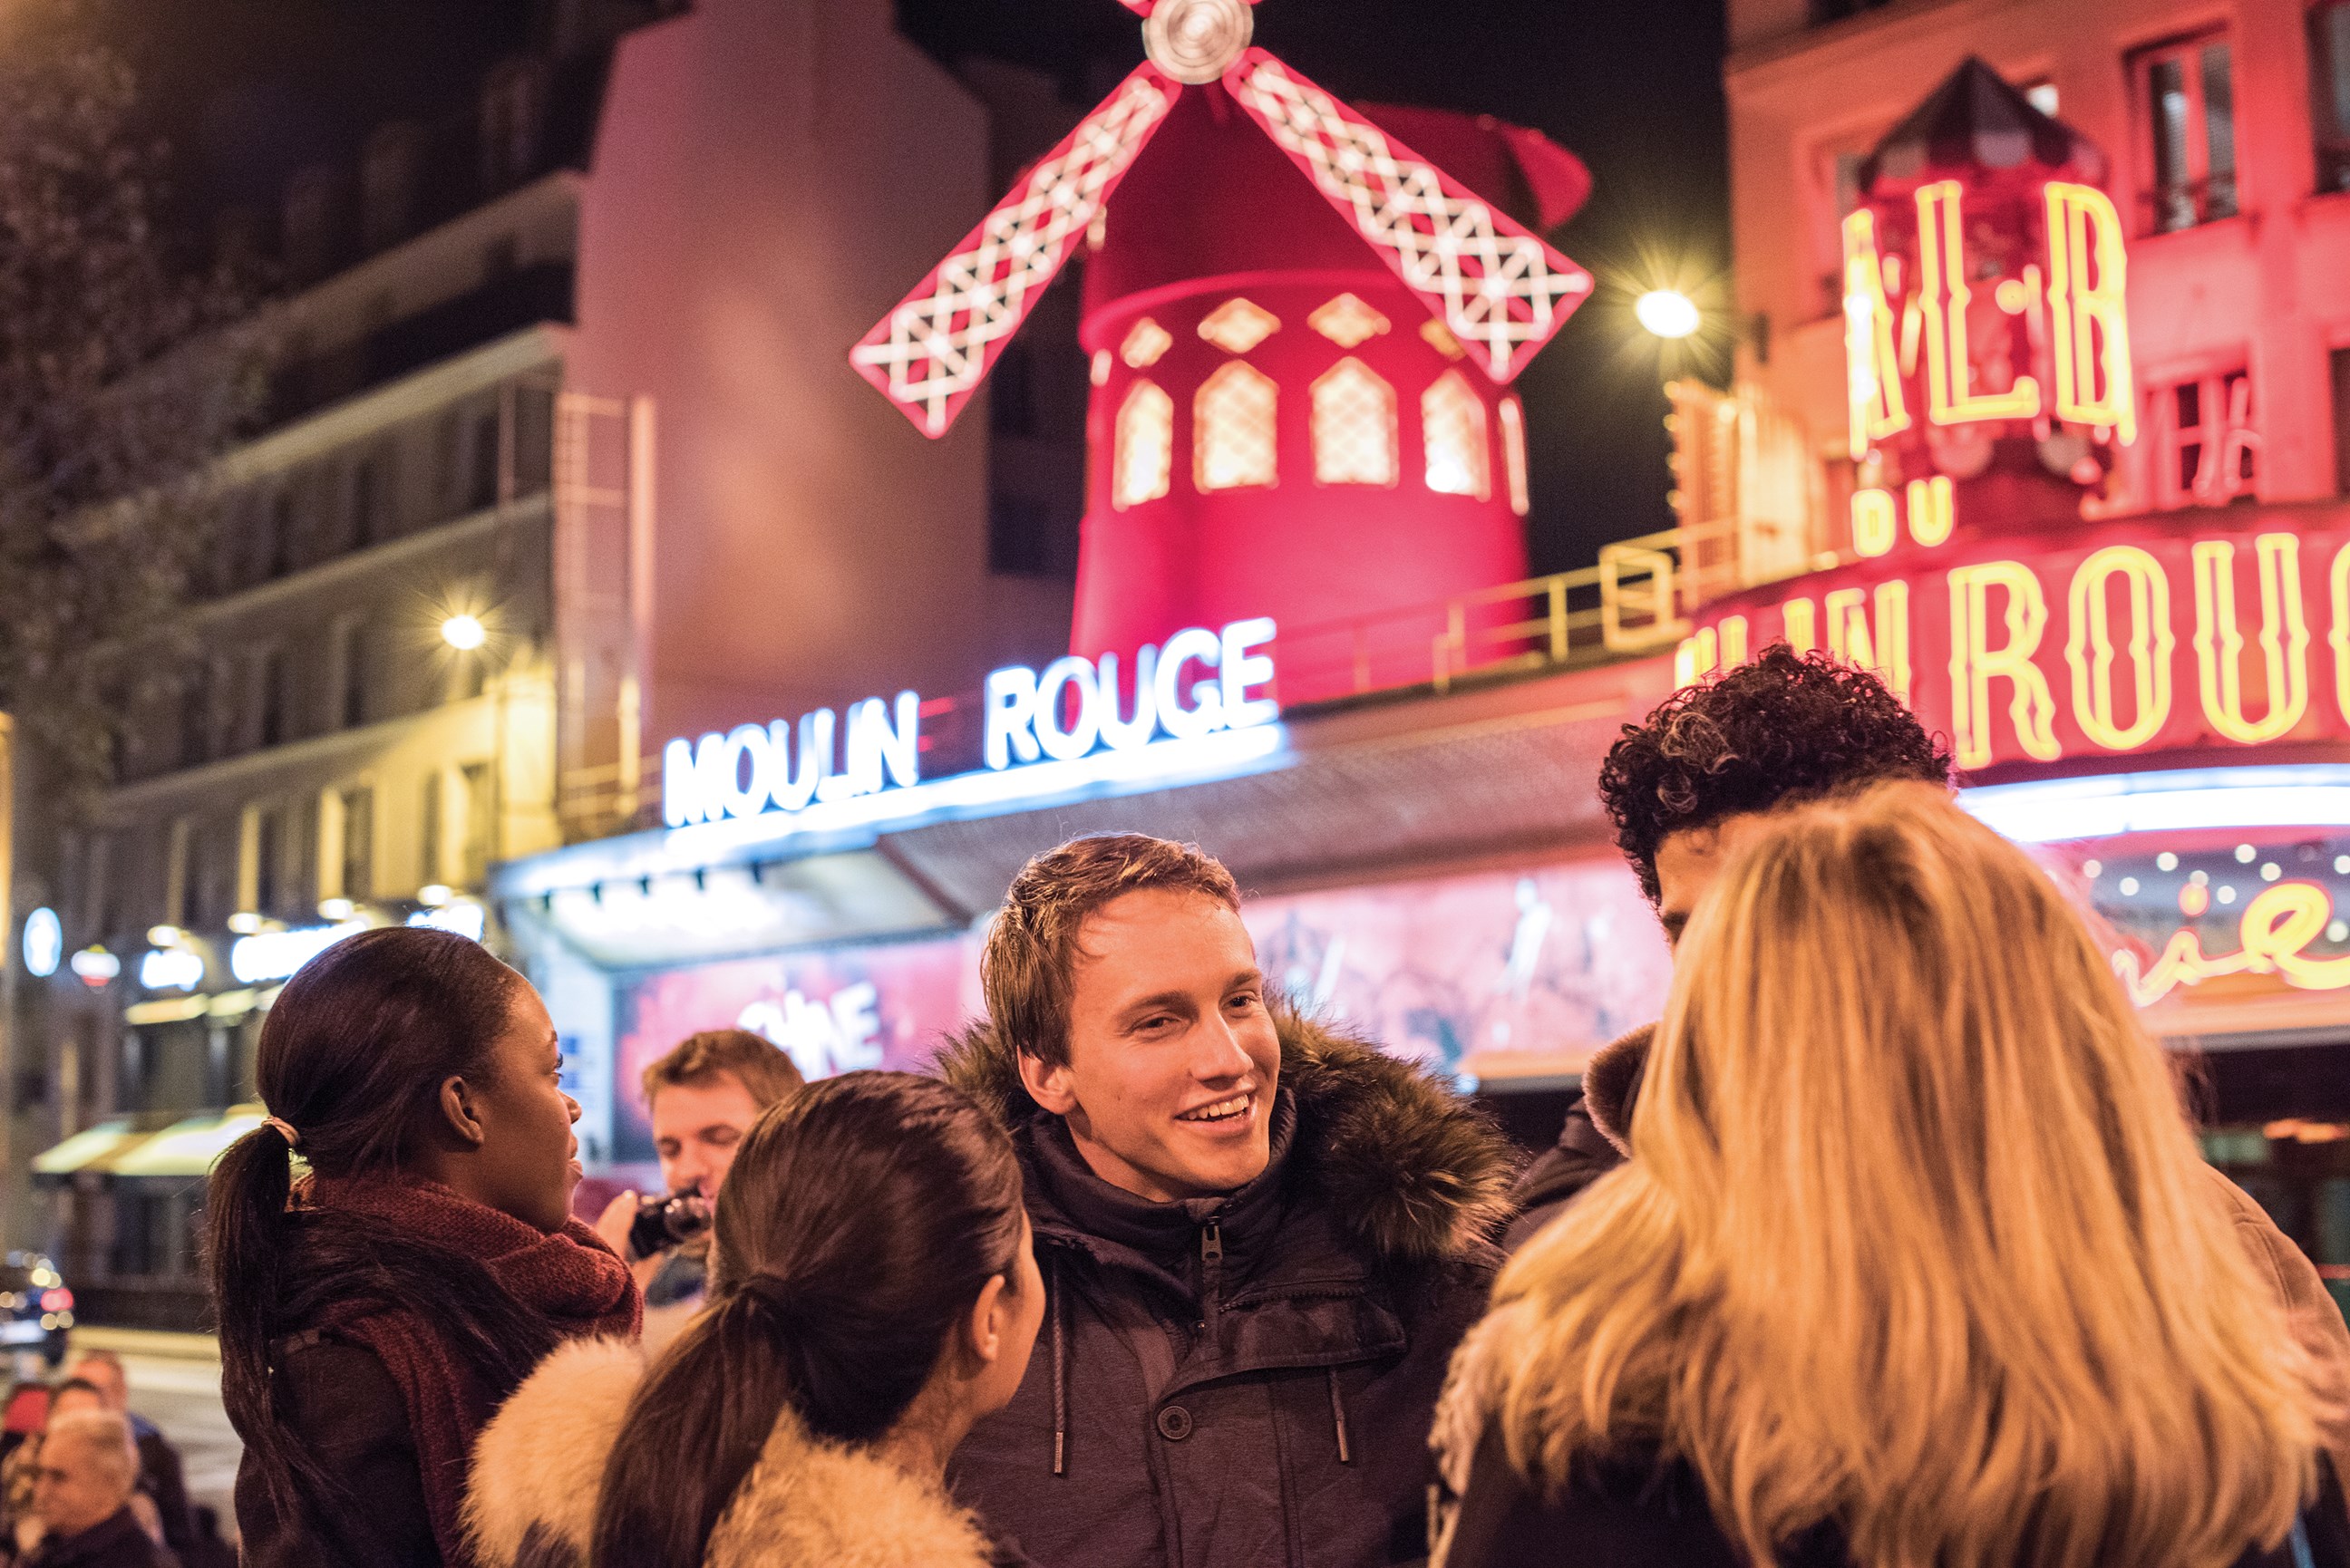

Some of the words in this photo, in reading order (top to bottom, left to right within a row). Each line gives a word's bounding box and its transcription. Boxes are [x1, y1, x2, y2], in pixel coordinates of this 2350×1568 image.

[1851, 476, 1955, 557] DU
[665, 690, 918, 828] MOULIN
[985, 617, 1279, 770] ROUGE
[1947, 532, 2350, 769] ROU
